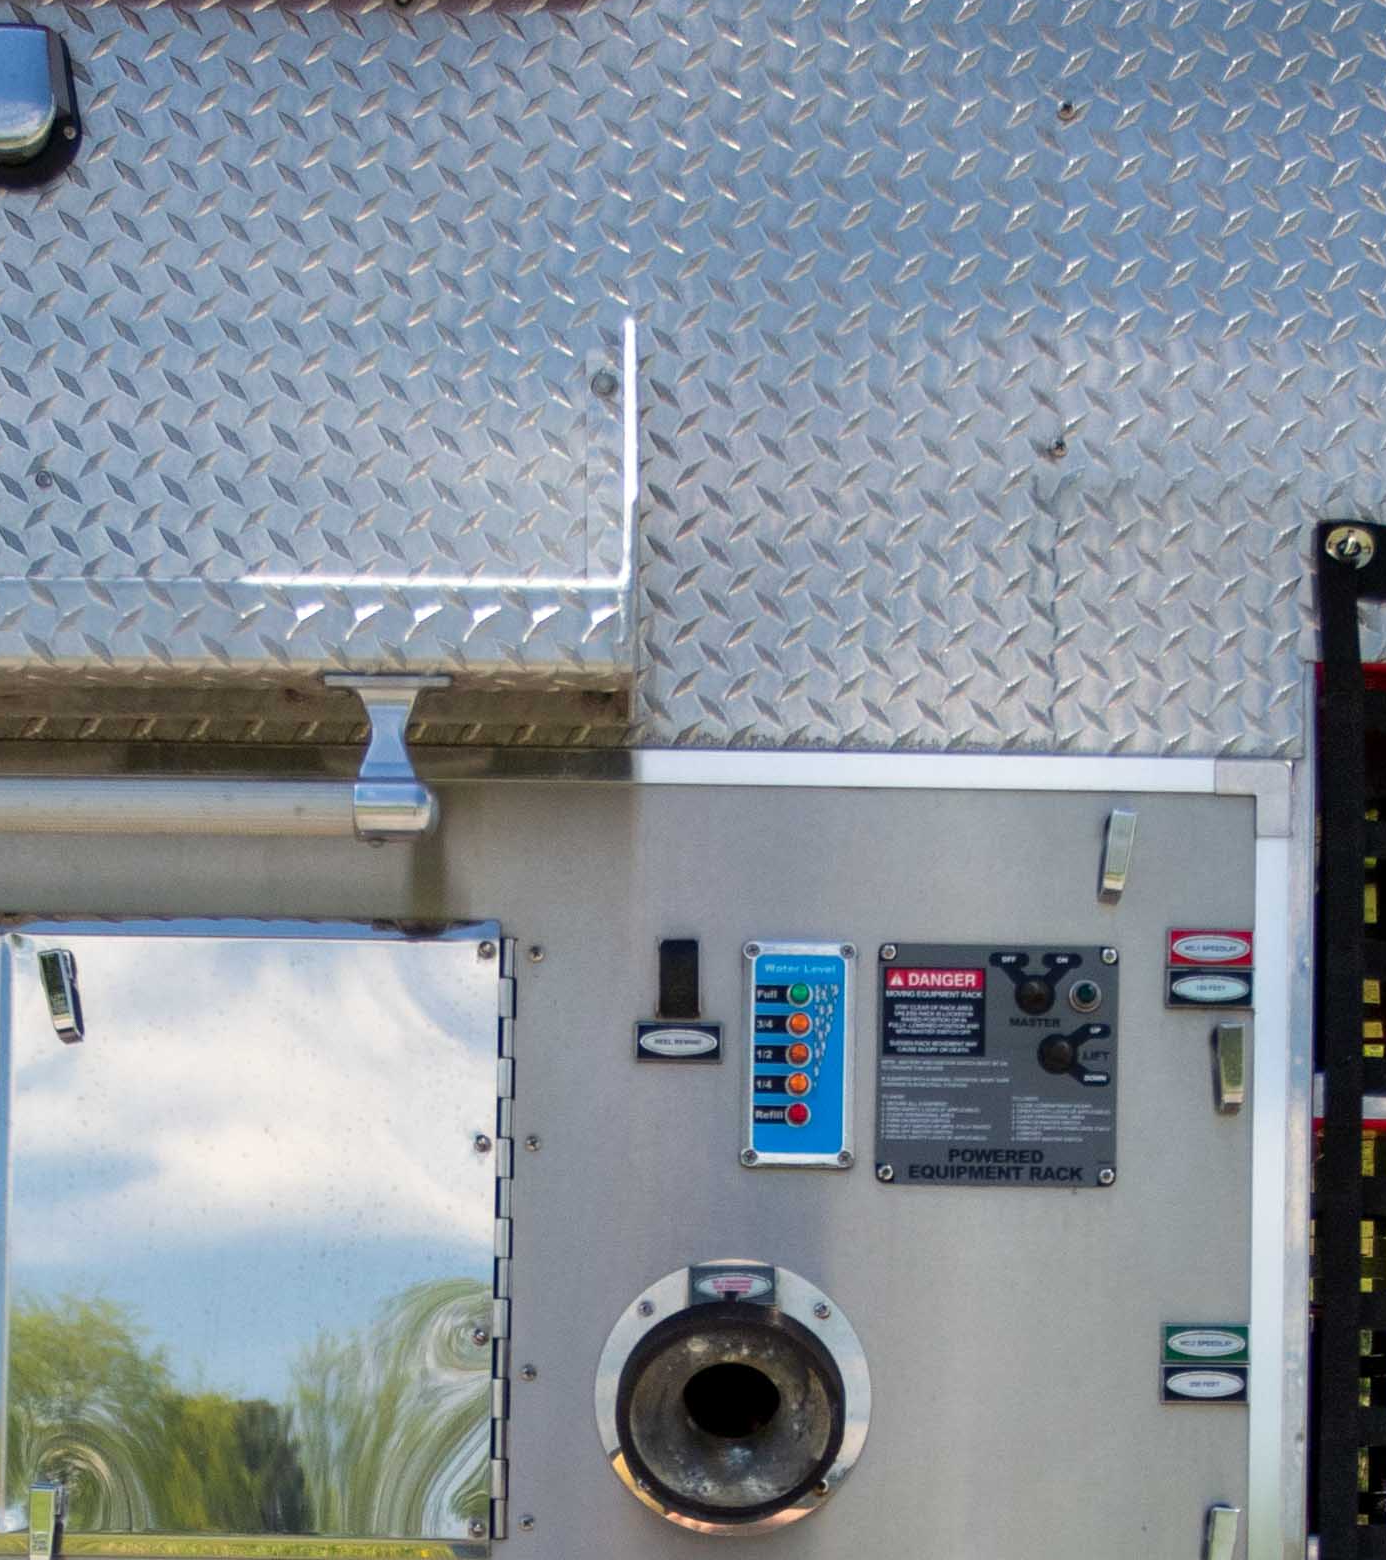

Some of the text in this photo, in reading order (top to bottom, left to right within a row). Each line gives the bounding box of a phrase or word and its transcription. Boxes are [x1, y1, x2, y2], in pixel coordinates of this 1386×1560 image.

[1055, 956, 1069, 964] ON
[764, 964, 837, 974] Water Level
[908, 973, 975, 986] DANGER
[757, 990, 777, 1000] Full
[886, 990, 983, 998] MOVING EQUIPMENT RACK
[757, 1020, 773, 1029] 3/4
[1009, 1017, 1060, 1028] MASTER
[757, 1050, 773, 1060] 1/2
[1083, 1051, 1110, 1060] LIFT
[757, 1080, 773, 1090] 1/4
[755, 1110, 783, 1120] Refill
[948, 1148, 1044, 1164] POWERED
[909, 1165, 1083, 1180] EQUIPMENT RACK
